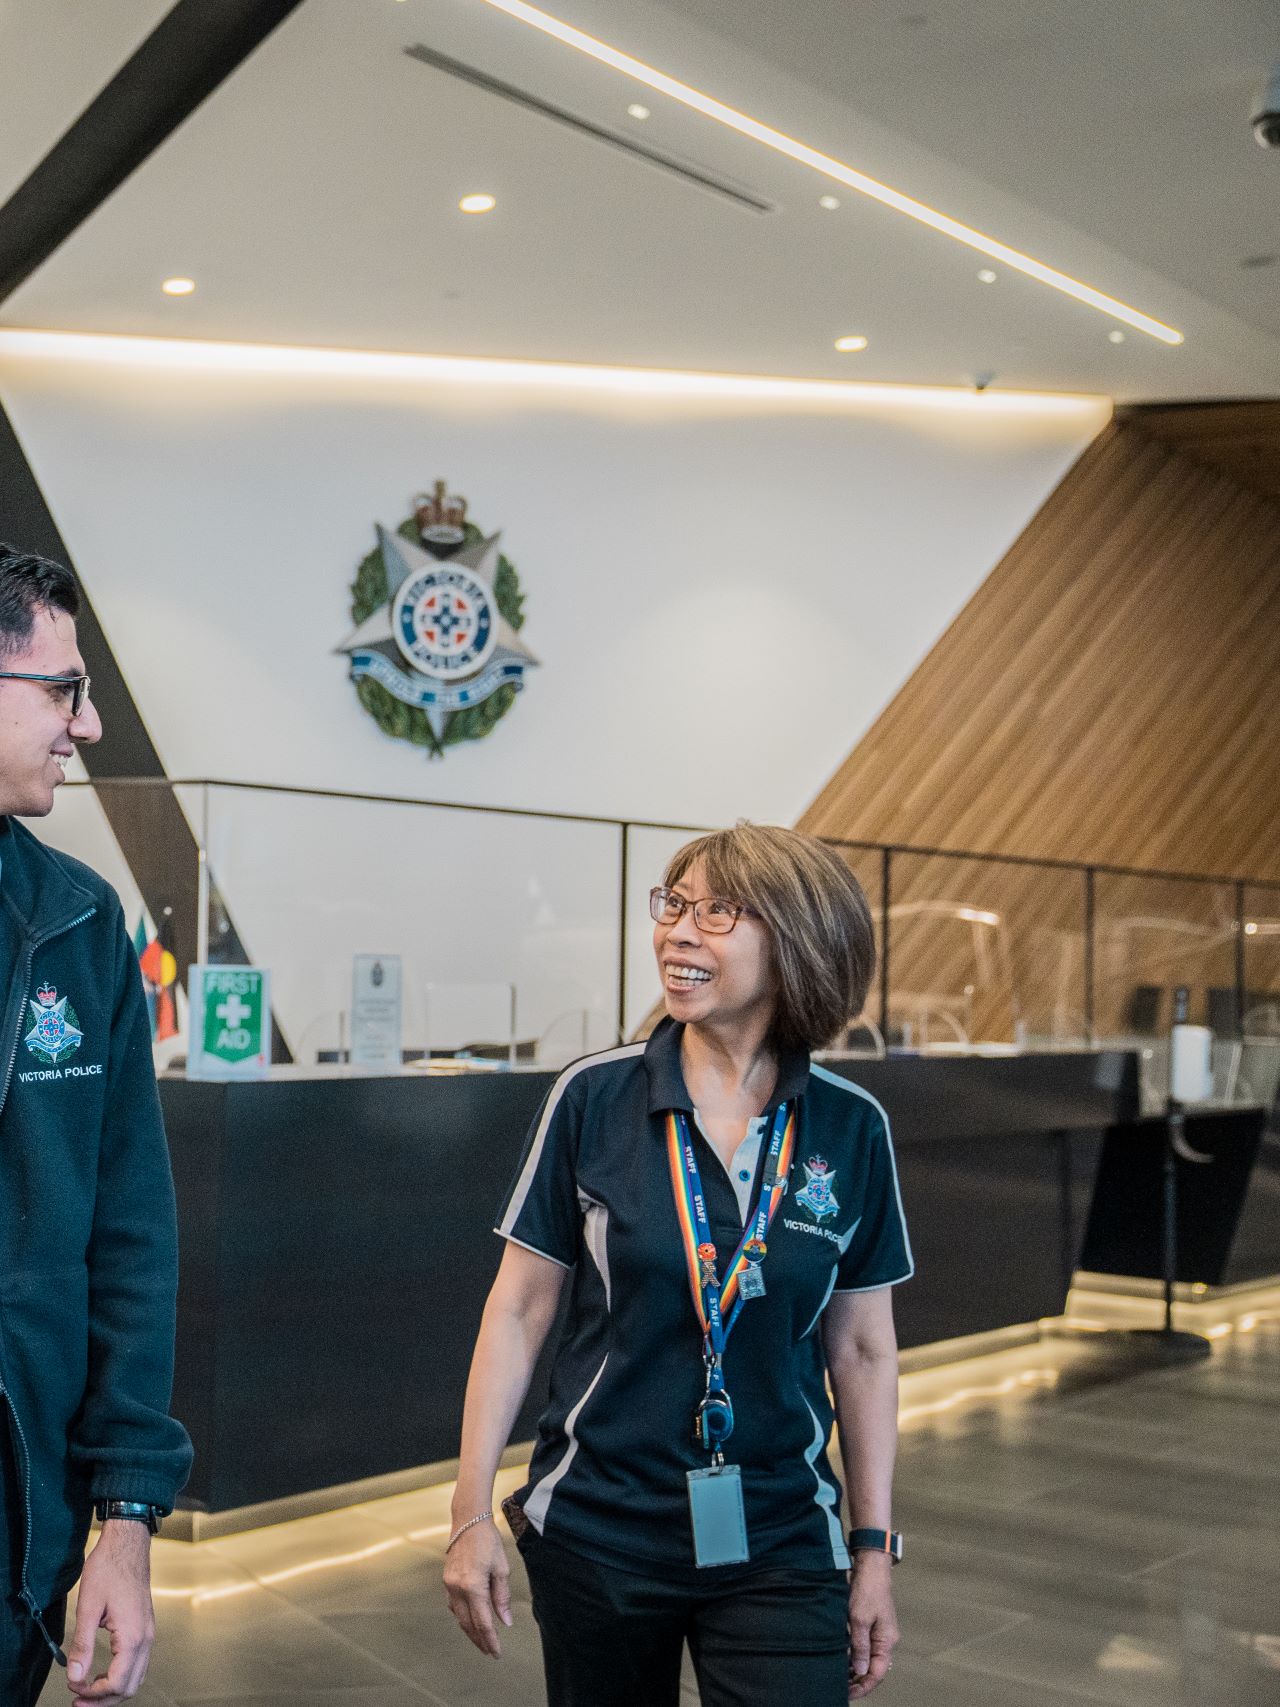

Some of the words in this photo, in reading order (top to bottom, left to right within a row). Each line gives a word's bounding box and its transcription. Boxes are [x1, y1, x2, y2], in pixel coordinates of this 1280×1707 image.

[206, 973, 259, 996] FIRST
[216, 1028, 251, 1051] AID
[18, 1069, 63, 1083] VICTORIA
[64, 1064, 103, 1078] POLICE
[770, 1130, 782, 1156] STAFF
[685, 1145, 697, 1174] STAFF
[694, 1194, 707, 1224] STAFF
[755, 1211, 767, 1242] STAFF
[783, 1218, 824, 1237] VICTORIA
[709, 1297, 720, 1327] STAFF
